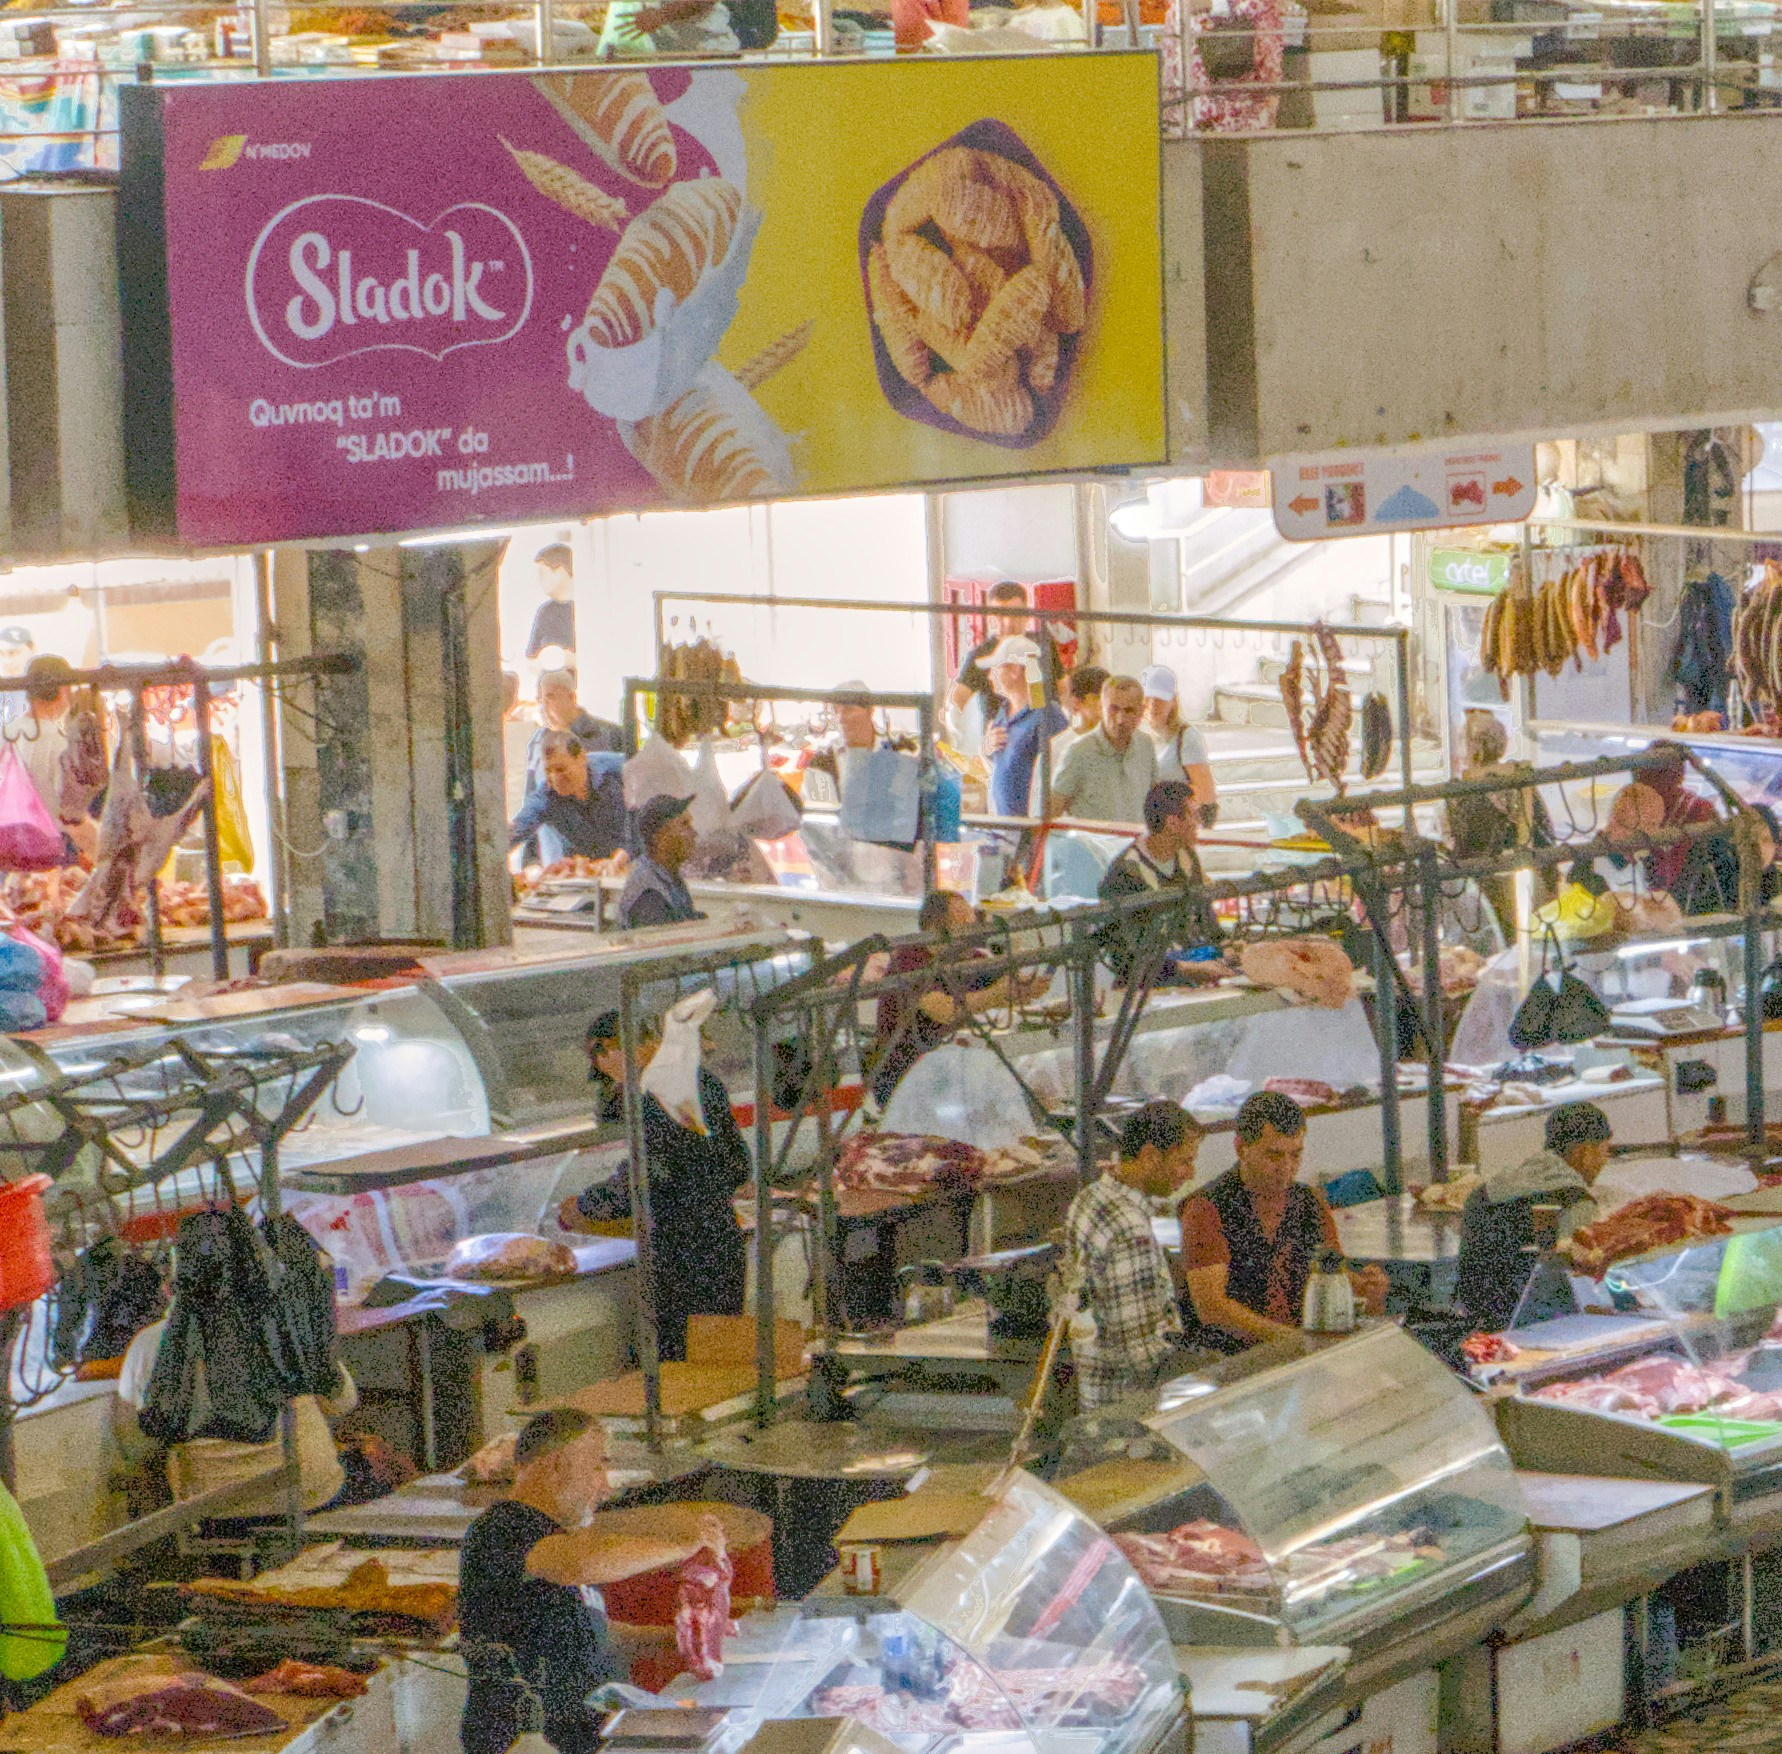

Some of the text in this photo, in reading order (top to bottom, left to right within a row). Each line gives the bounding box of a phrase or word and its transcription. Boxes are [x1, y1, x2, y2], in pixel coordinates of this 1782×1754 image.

[286, 229, 507, 340] Sladok
[249, 391, 401, 428] Quvnoq ta'm
[458, 426, 489, 454] da
